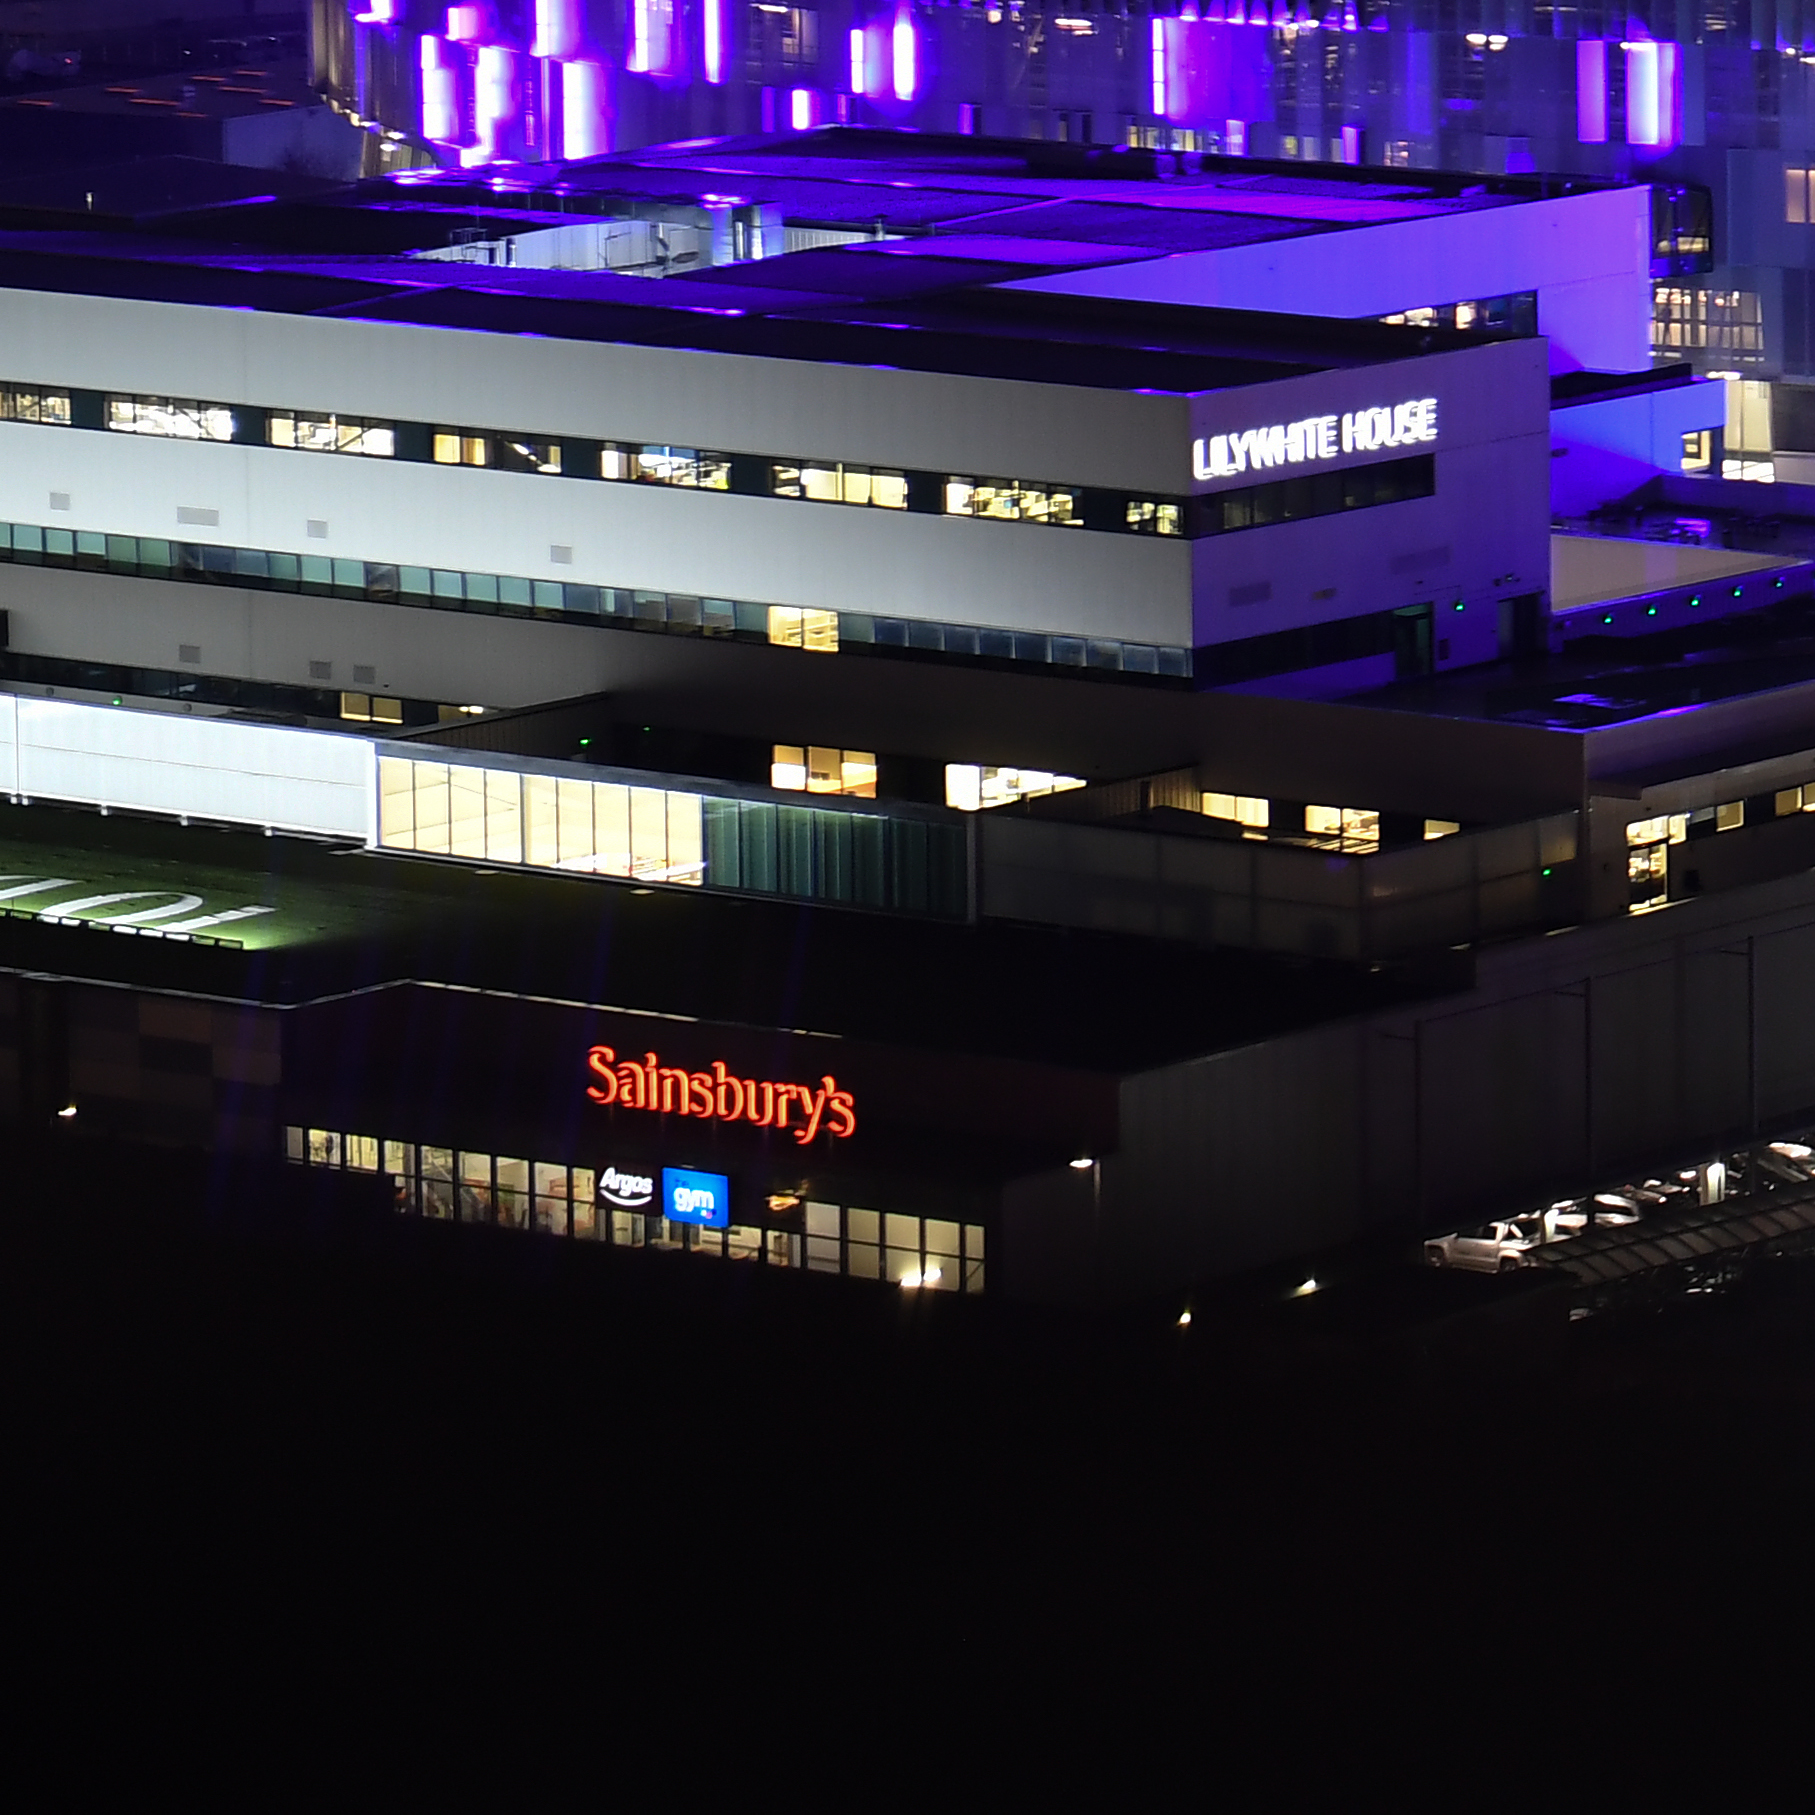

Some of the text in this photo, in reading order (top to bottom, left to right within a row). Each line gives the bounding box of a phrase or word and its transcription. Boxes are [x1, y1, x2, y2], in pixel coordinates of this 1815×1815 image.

[1193, 397, 1438, 480] LILYWHITE HOUSE
[587, 1045, 857, 1144] Sainsbury's
[600, 1166, 653, 1197] Argos
[673, 1187, 715, 1213] gym
